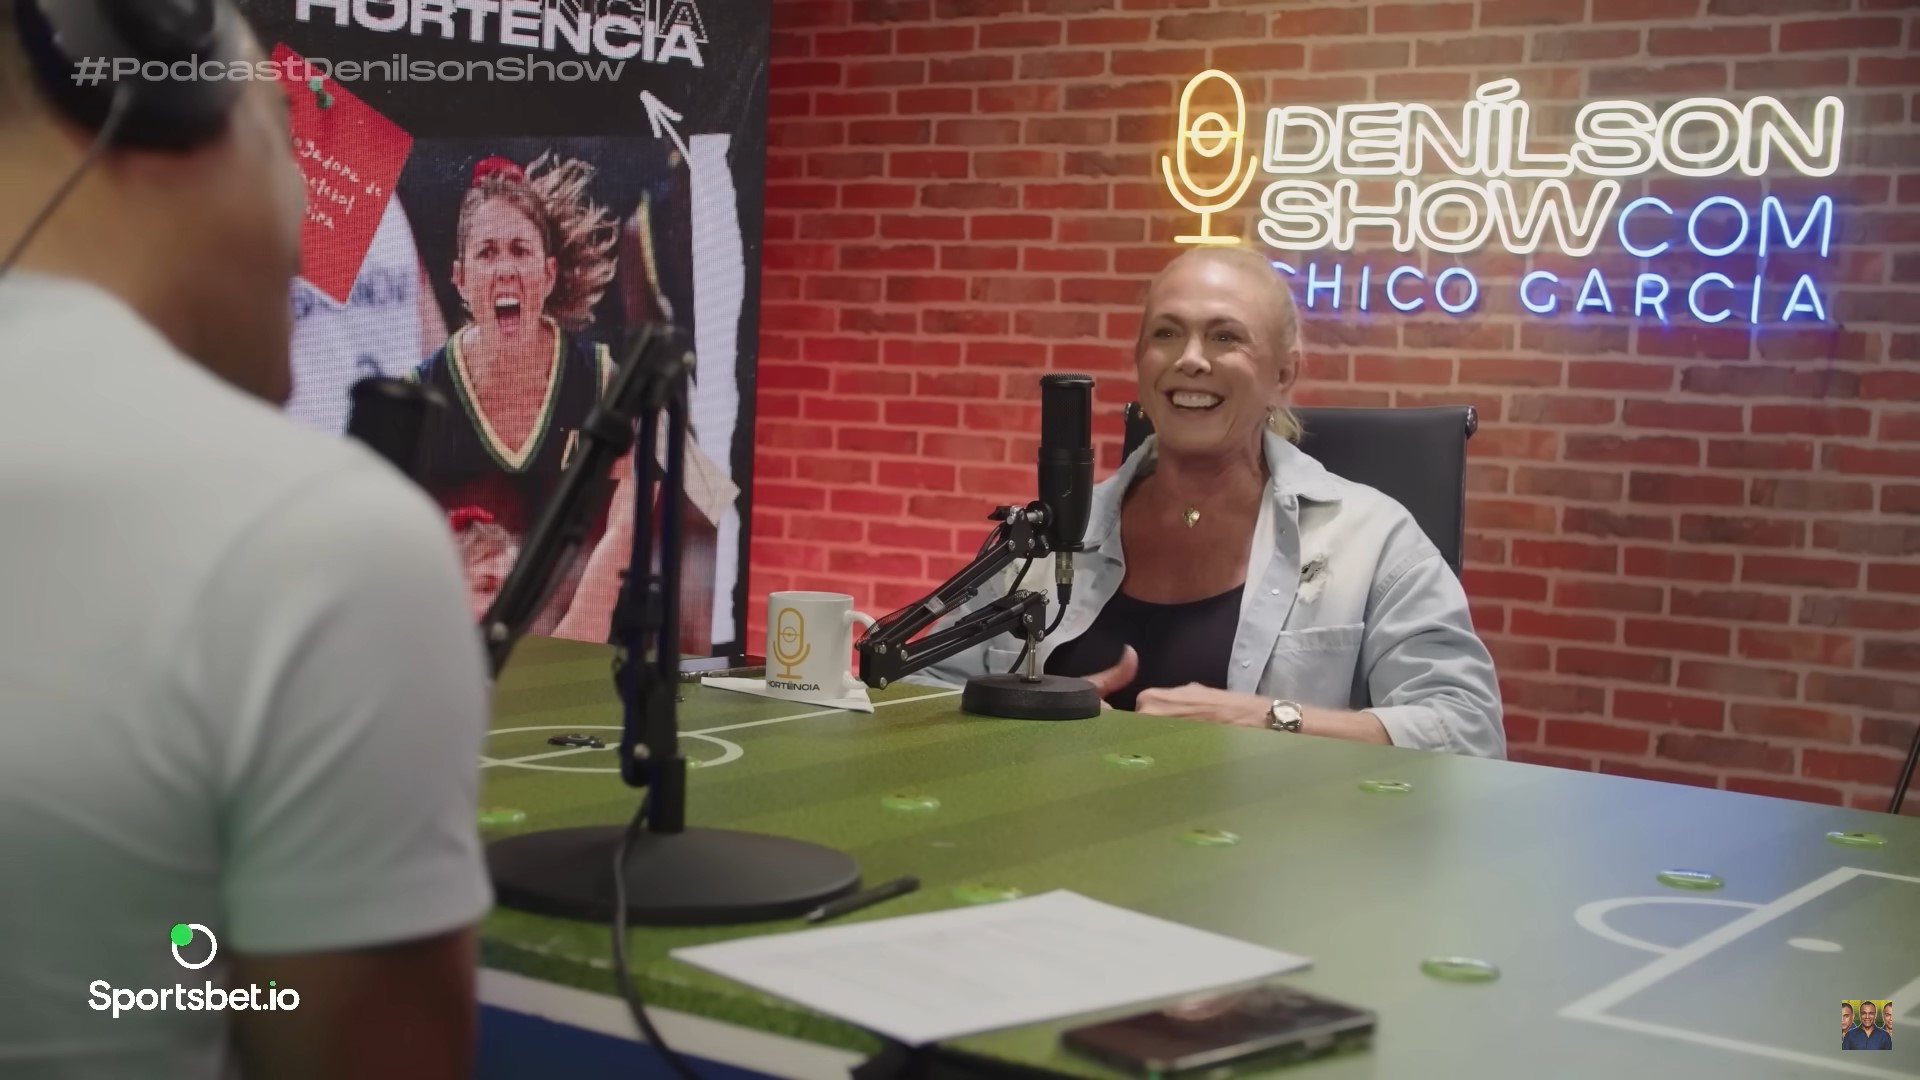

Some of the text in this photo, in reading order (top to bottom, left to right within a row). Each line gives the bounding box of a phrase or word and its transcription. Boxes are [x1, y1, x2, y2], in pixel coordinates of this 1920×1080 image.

[1262, 77, 1844, 177] DENÍLSON
[1258, 178, 1832, 258] SHOW COM
[1271, 260, 1825, 324] HICO GARCIA
